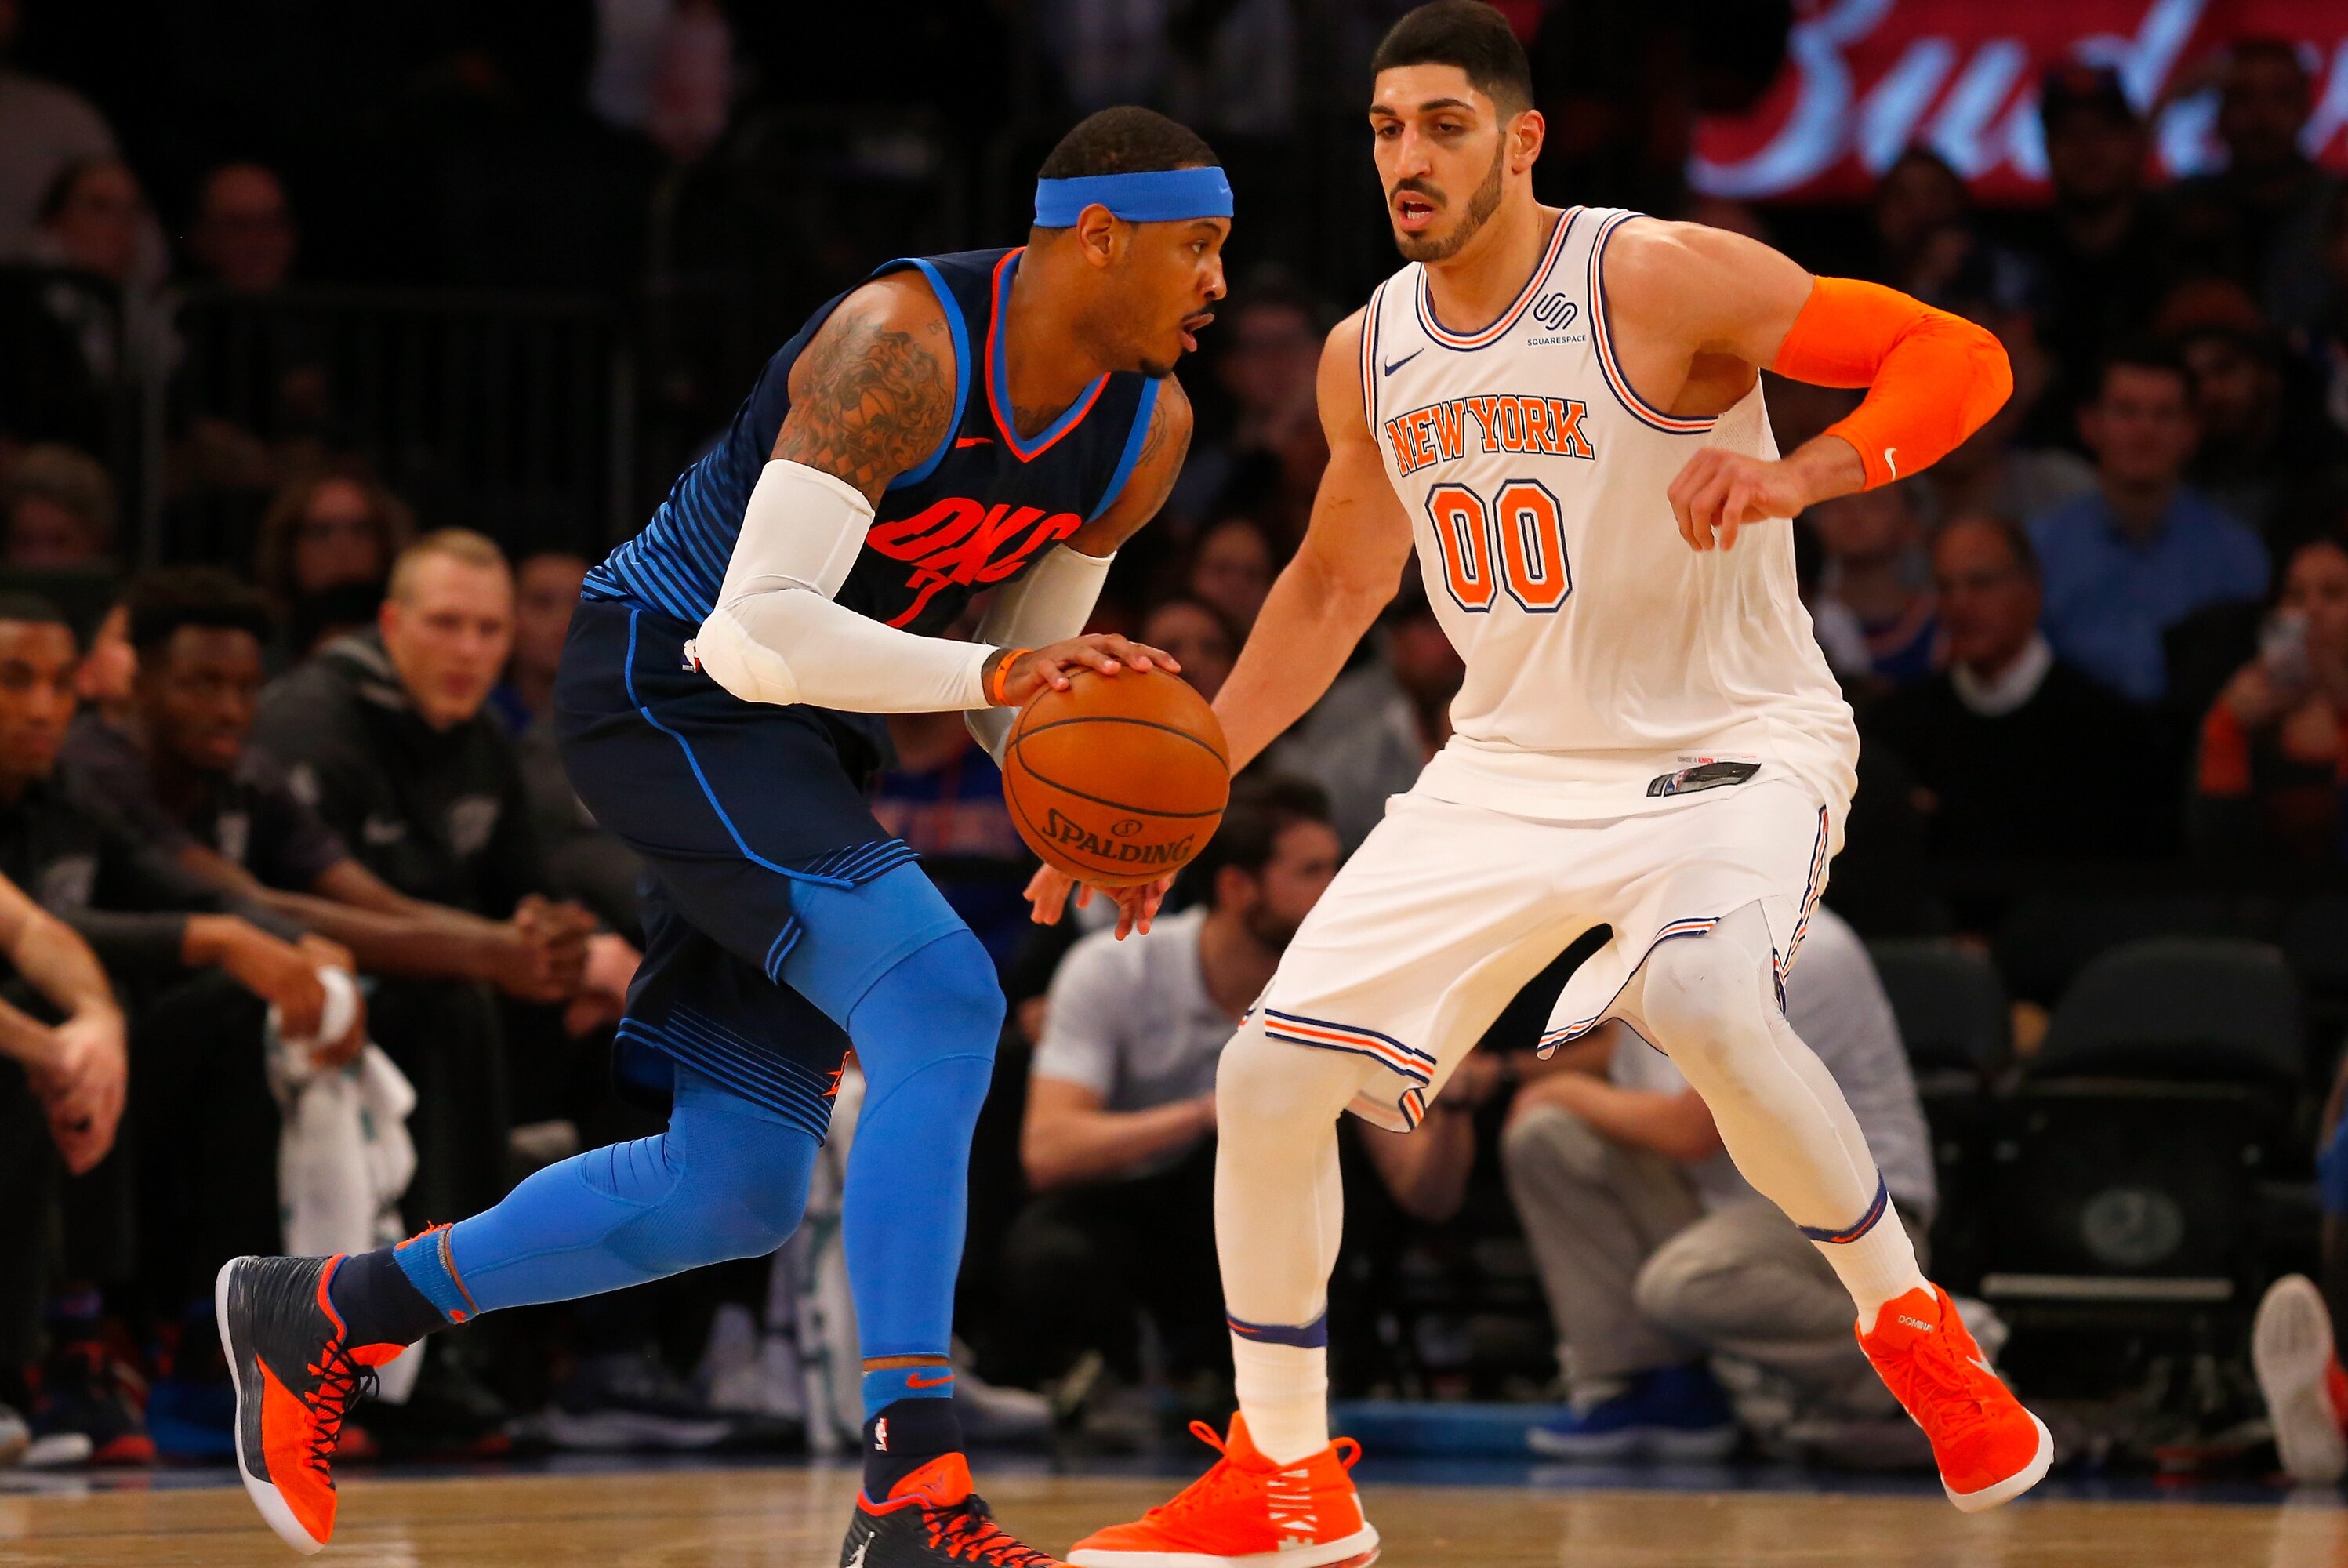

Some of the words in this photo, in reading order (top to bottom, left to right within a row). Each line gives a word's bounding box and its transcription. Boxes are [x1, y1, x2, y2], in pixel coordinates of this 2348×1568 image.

[1527, 334, 1587, 347] SQUARESPACE
[1384, 397, 1466, 477] NEW
[1466, 394, 1595, 460] YORK
[866, 497, 1082, 586] OKC
[1424, 478, 1573, 613] 00
[1042, 808, 1195, 864] SPALDING
